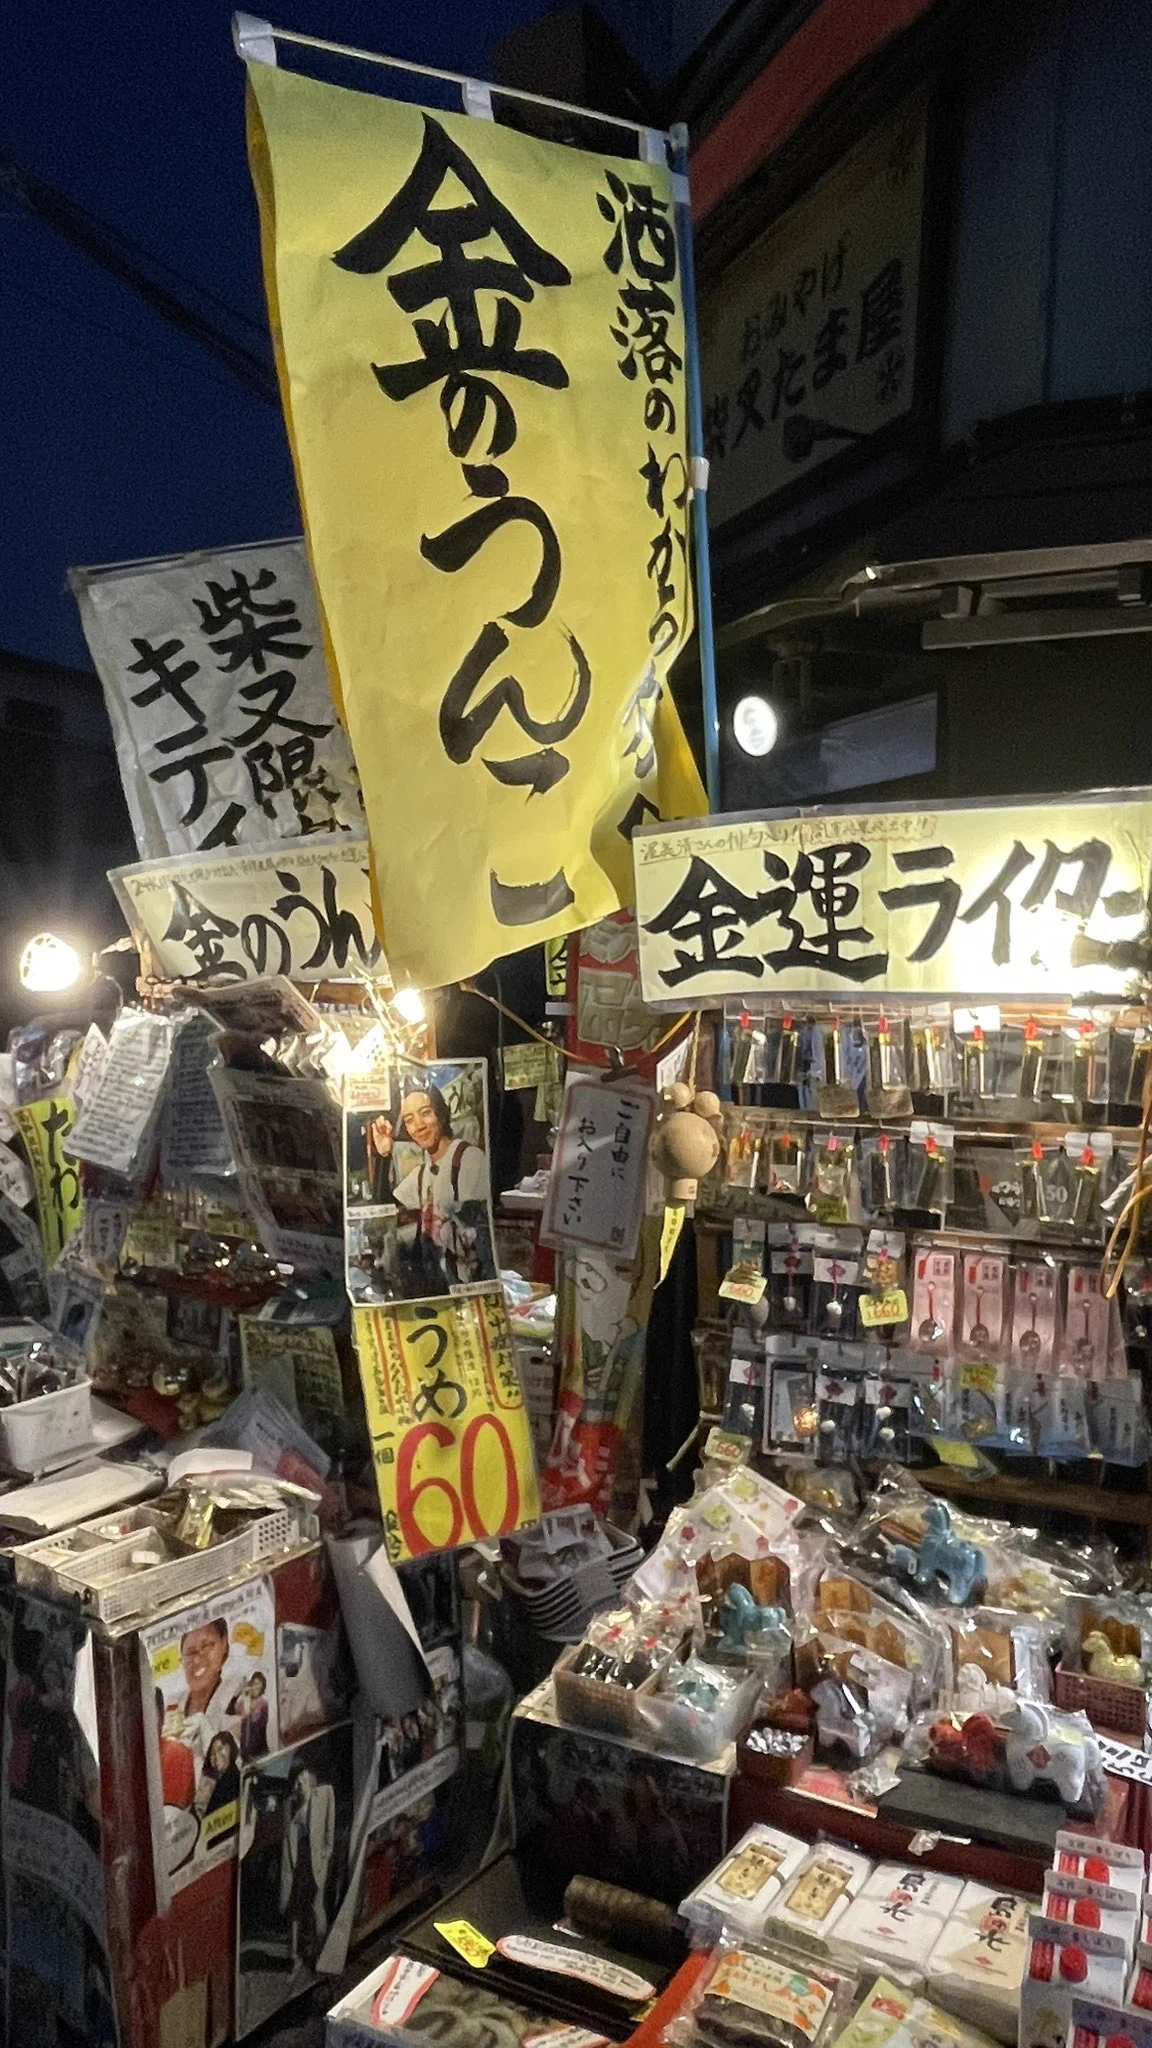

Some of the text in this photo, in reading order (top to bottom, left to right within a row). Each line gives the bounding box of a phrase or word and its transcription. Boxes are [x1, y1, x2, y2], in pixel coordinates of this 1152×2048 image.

[330, 112, 591, 926] 金のうんこ
[160, 864, 382, 981] 金のうん
[563, 1117, 596, 1225] お入り下さい
[611, 1099, 640, 1181] ご自由に
[396, 1413, 520, 1559] 60
